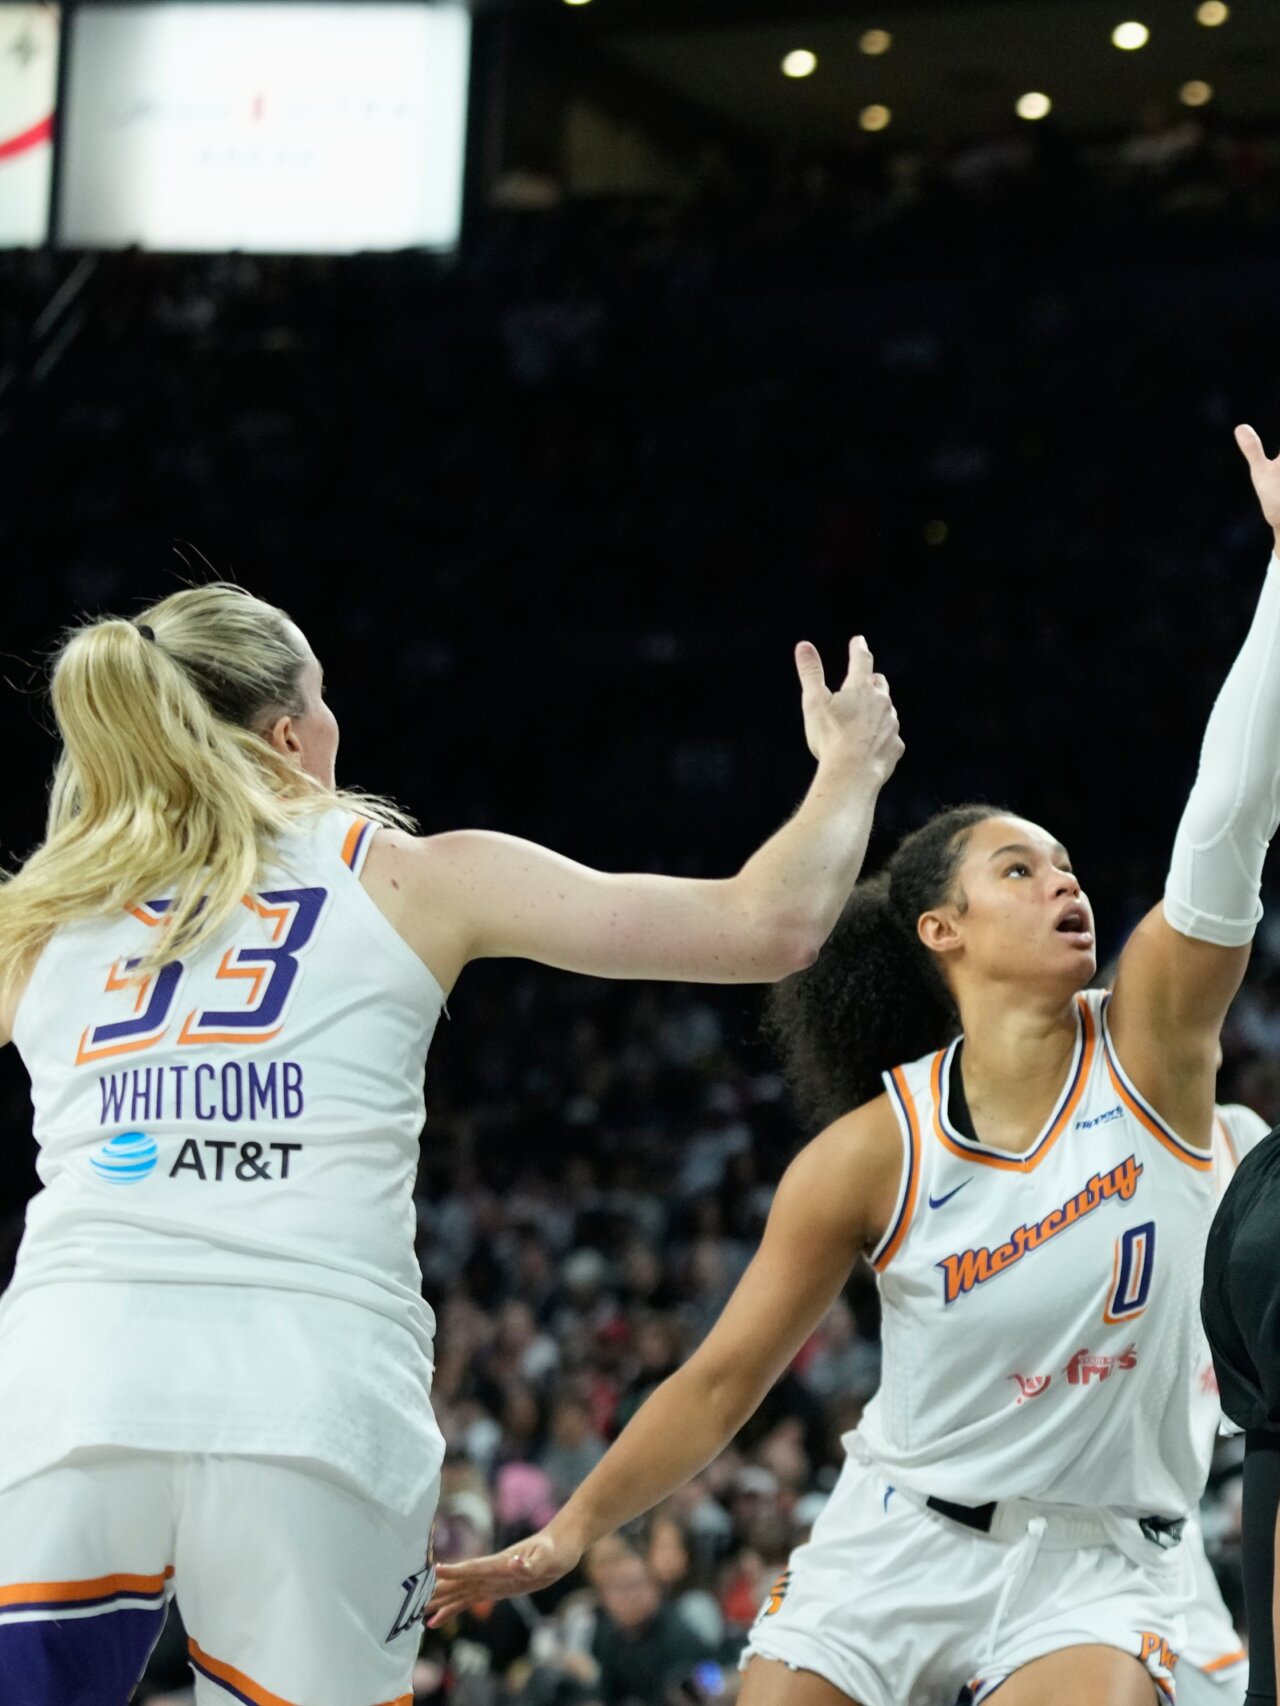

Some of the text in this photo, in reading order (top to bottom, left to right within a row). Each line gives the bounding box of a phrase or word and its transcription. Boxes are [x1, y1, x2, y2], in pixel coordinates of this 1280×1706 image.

[99, 1061, 304, 1125] WHITCOMB
[168, 1138, 303, 1182] AT&T
[935, 1153, 1144, 1306] Mercury
[1103, 1220, 1155, 1325] 0
